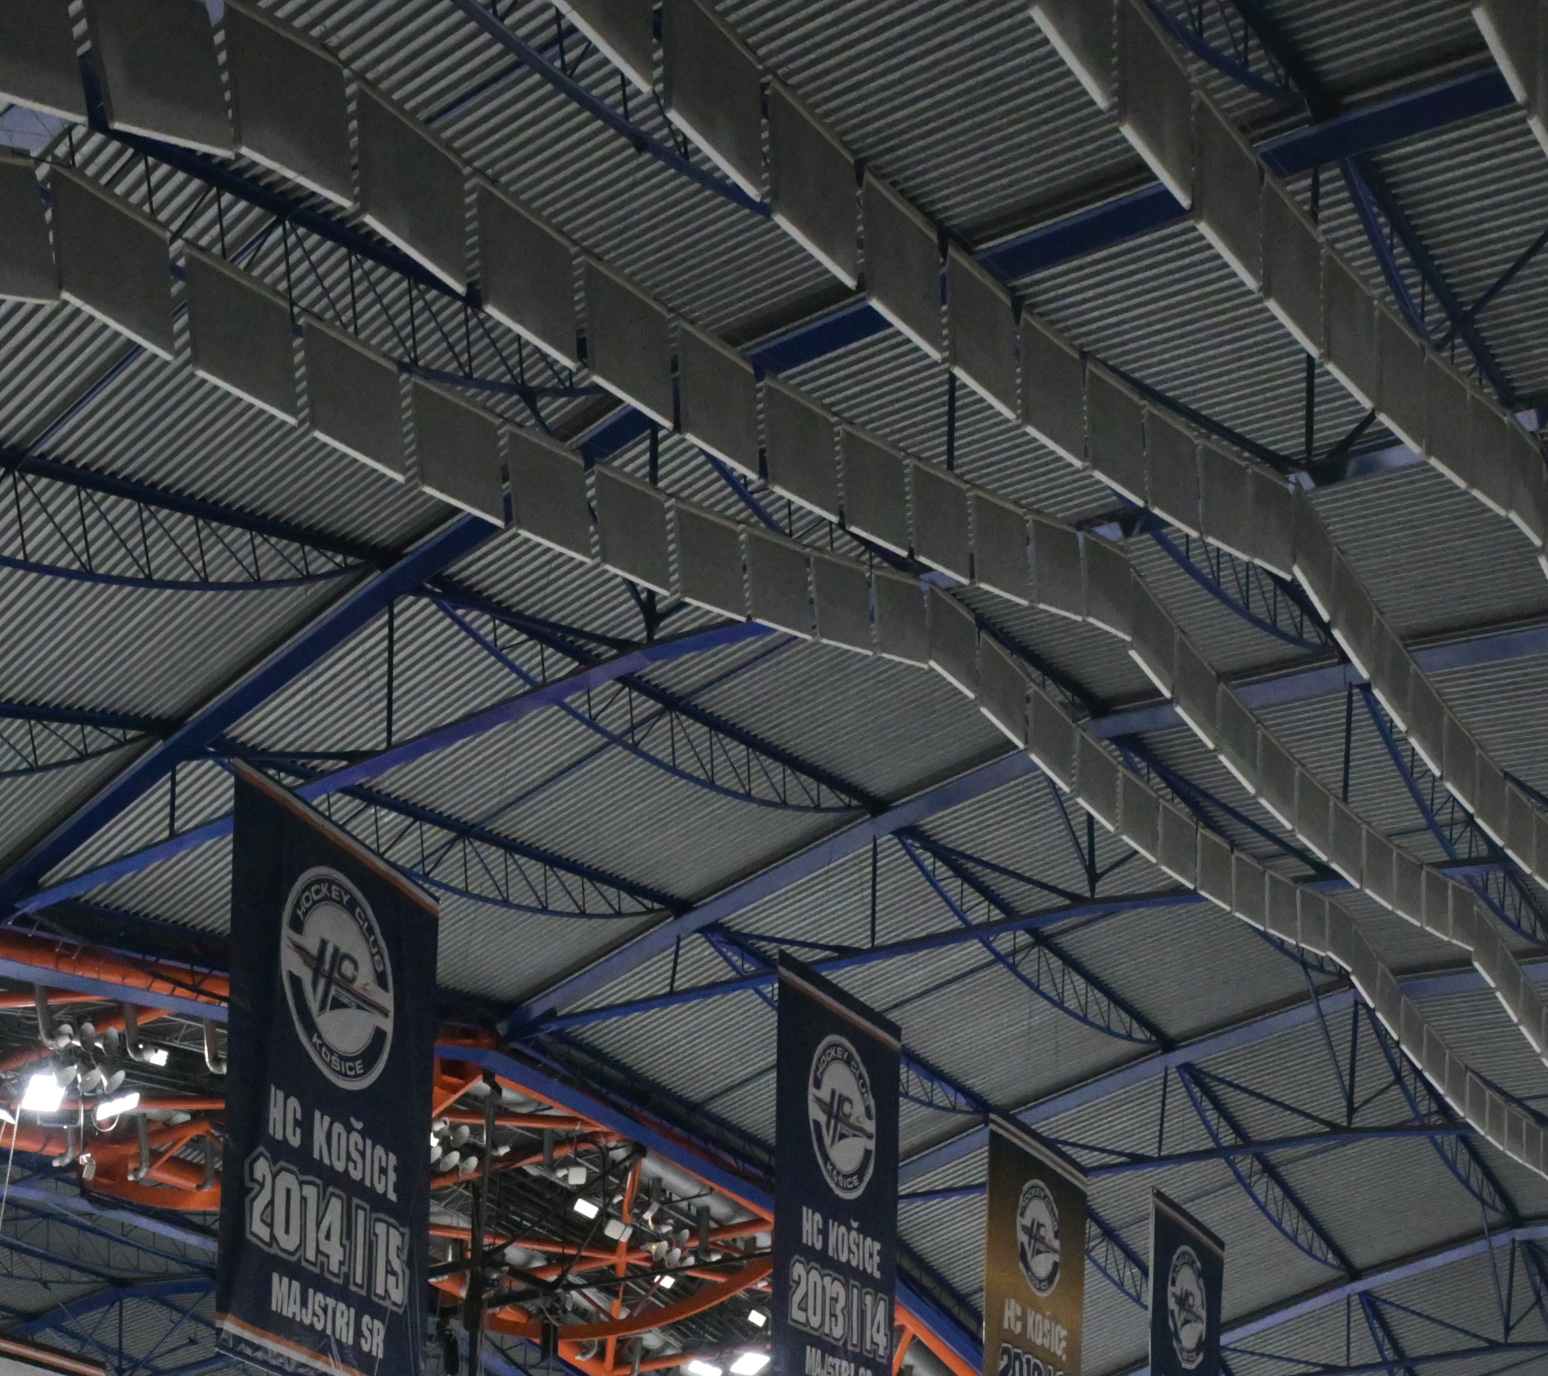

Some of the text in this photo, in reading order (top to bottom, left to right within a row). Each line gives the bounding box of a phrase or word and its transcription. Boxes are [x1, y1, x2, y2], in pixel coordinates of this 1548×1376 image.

[295, 881, 386, 975] HOCKEY CLUB
[310, 1032, 366, 1076] KOŠICE
[269, 1084, 397, 1202] HC KOŠICE
[802, 1206, 881, 1279] HC KOŠICE
[271, 1272, 385, 1359] MAJSTRI SR
